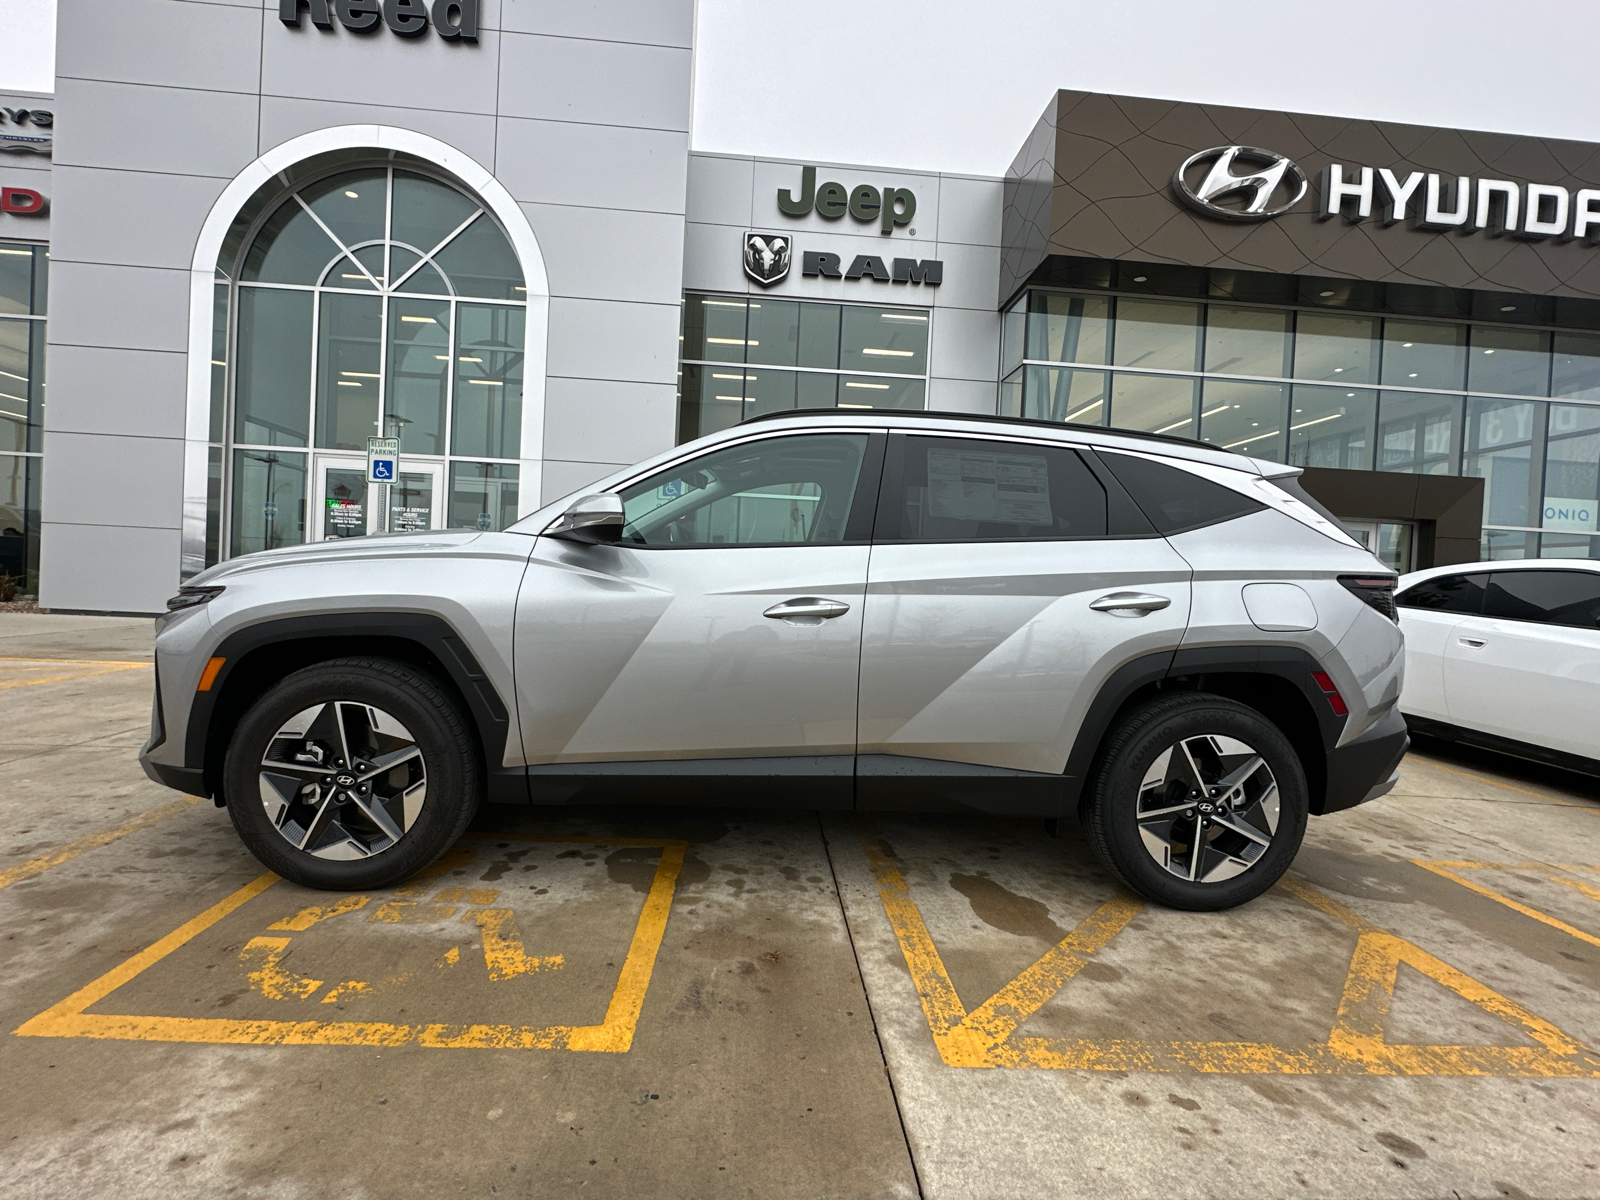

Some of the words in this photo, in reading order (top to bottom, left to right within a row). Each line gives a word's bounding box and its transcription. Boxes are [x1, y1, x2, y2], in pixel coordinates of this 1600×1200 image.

[777, 166, 917, 235] Jeep
[802, 250, 944, 286] RAM
[370, 440, 397, 448] RESERVED
[370, 448, 397, 456] PARKING
[1544, 507, 1589, 522] ONIQ
[1129, 726, 1173, 771] KUMHO
